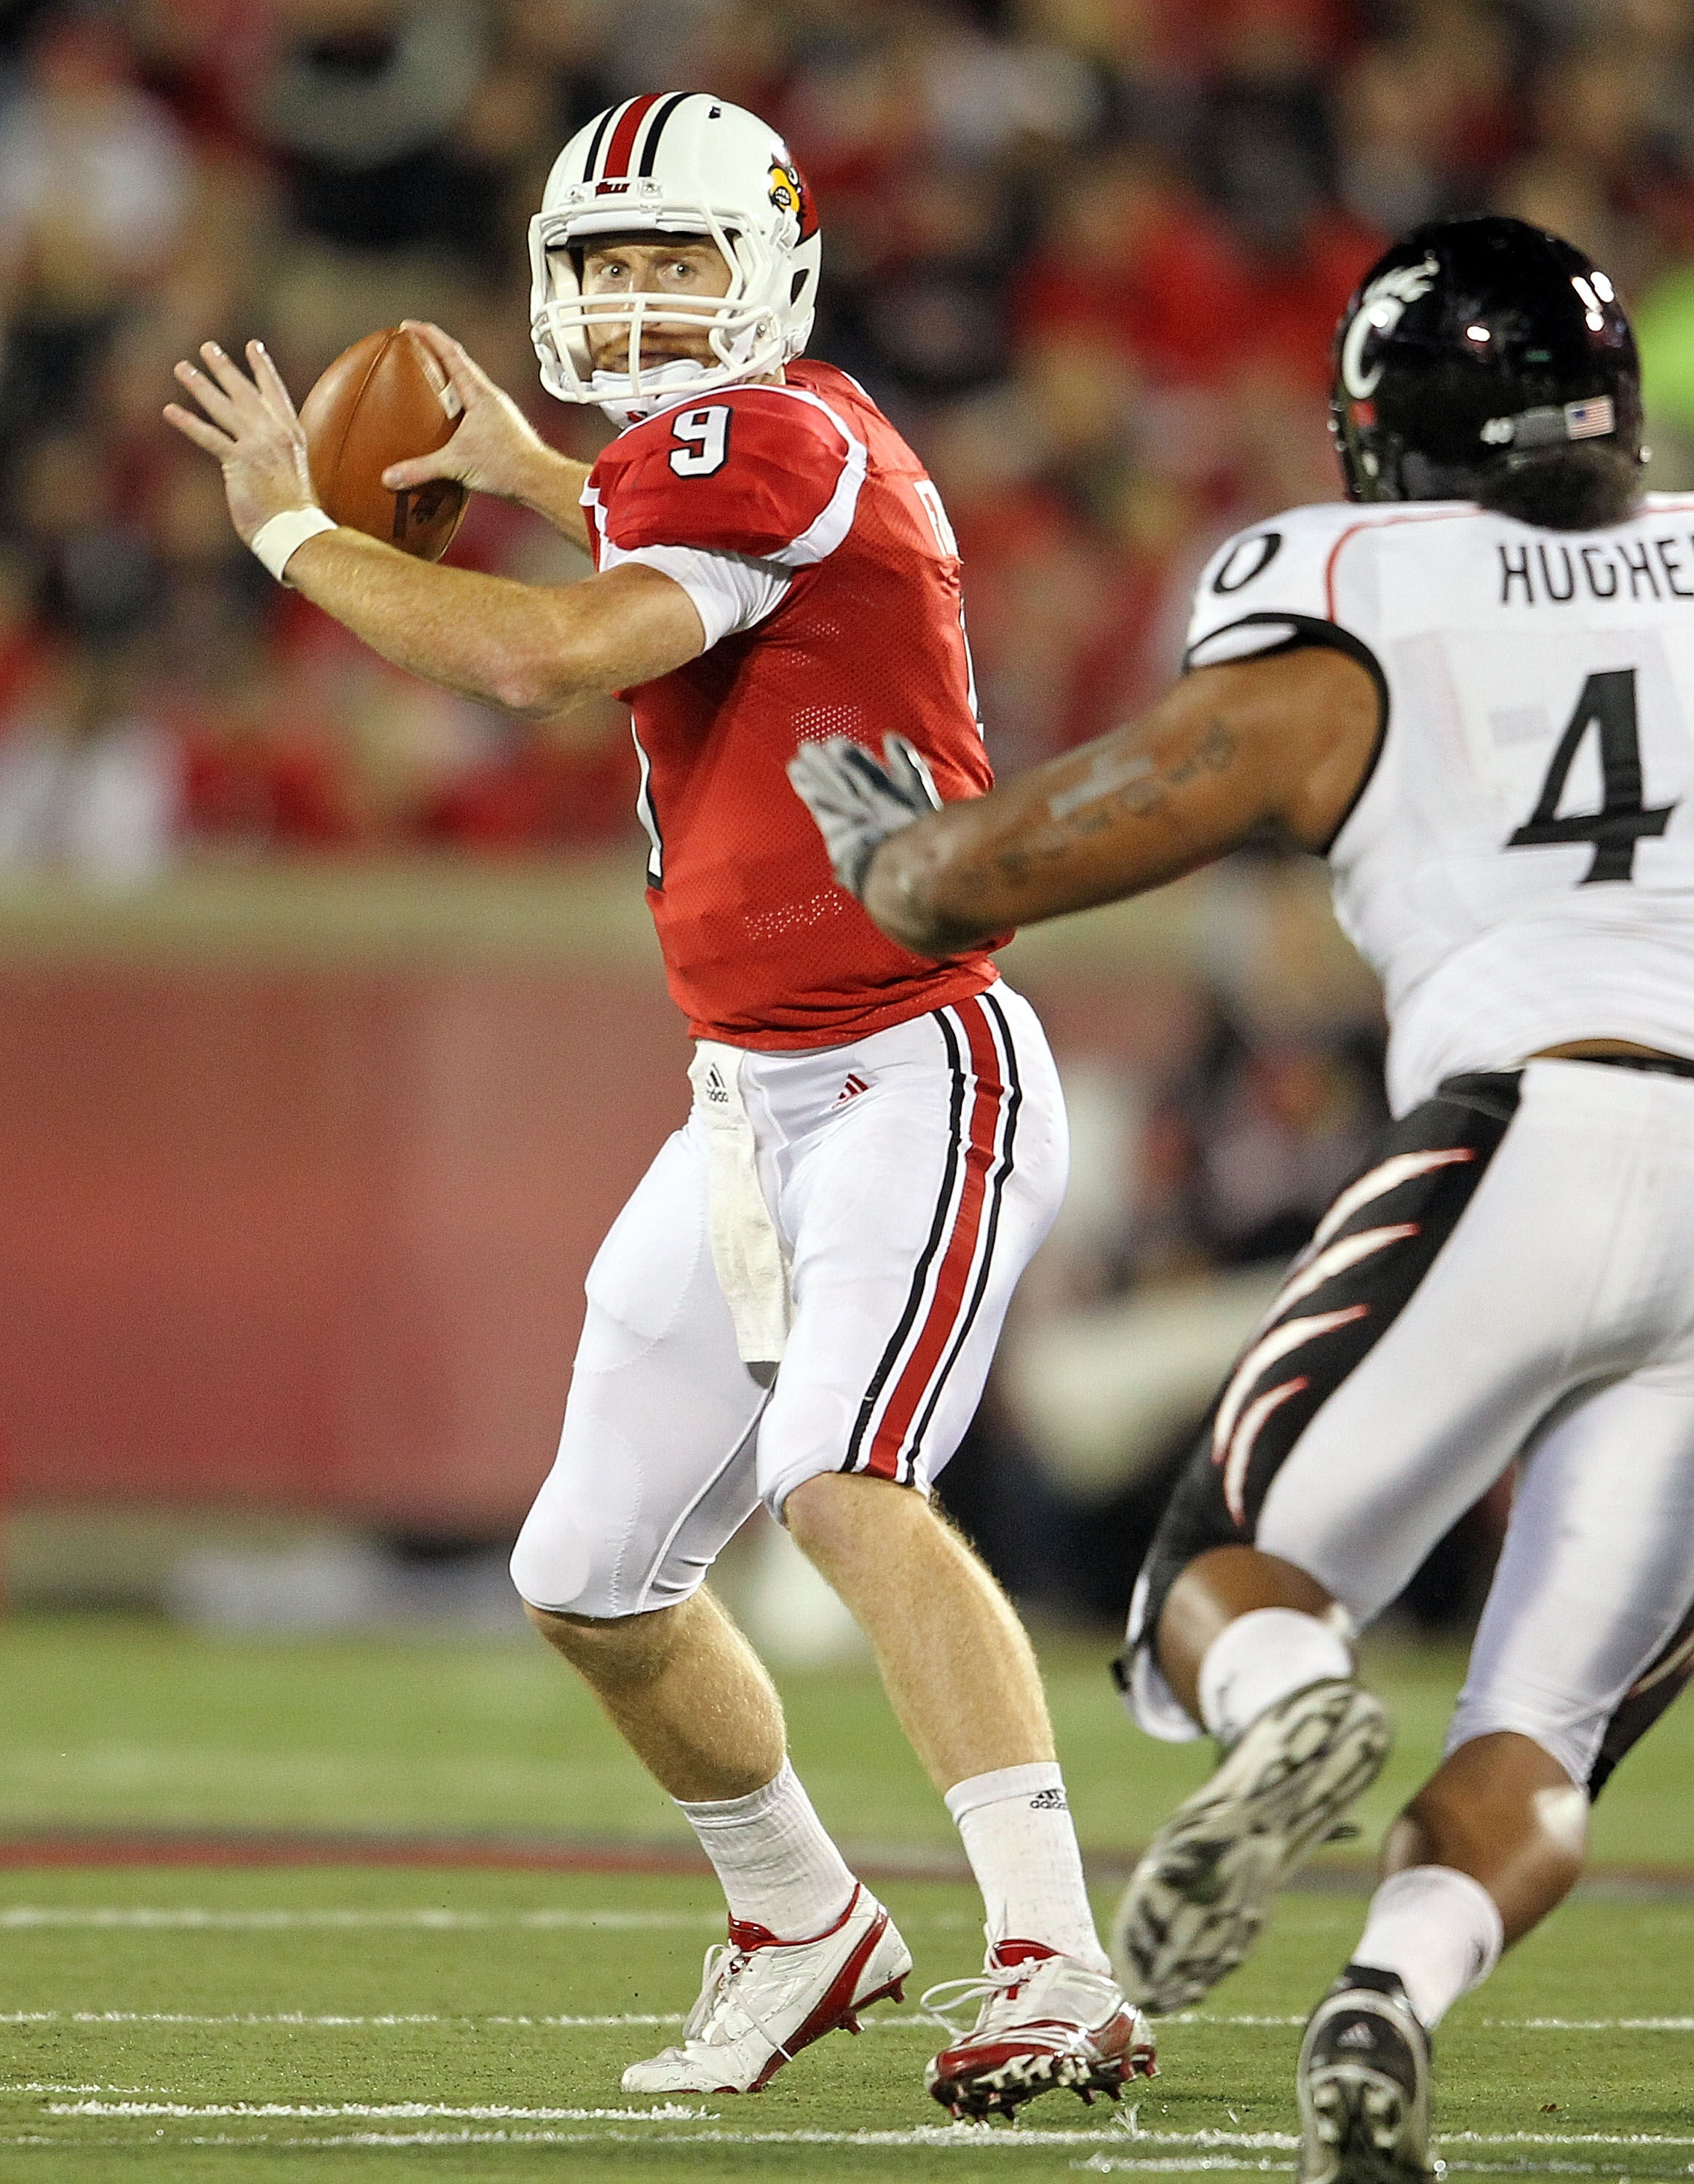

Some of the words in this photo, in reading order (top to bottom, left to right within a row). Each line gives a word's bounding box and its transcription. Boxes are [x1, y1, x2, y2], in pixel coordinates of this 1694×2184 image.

[669, 405, 732, 479] 9
[1213, 533, 1281, 593] 0
[1496, 535, 1694, 603] HUGHE
[1504, 668, 1674, 884] 4
